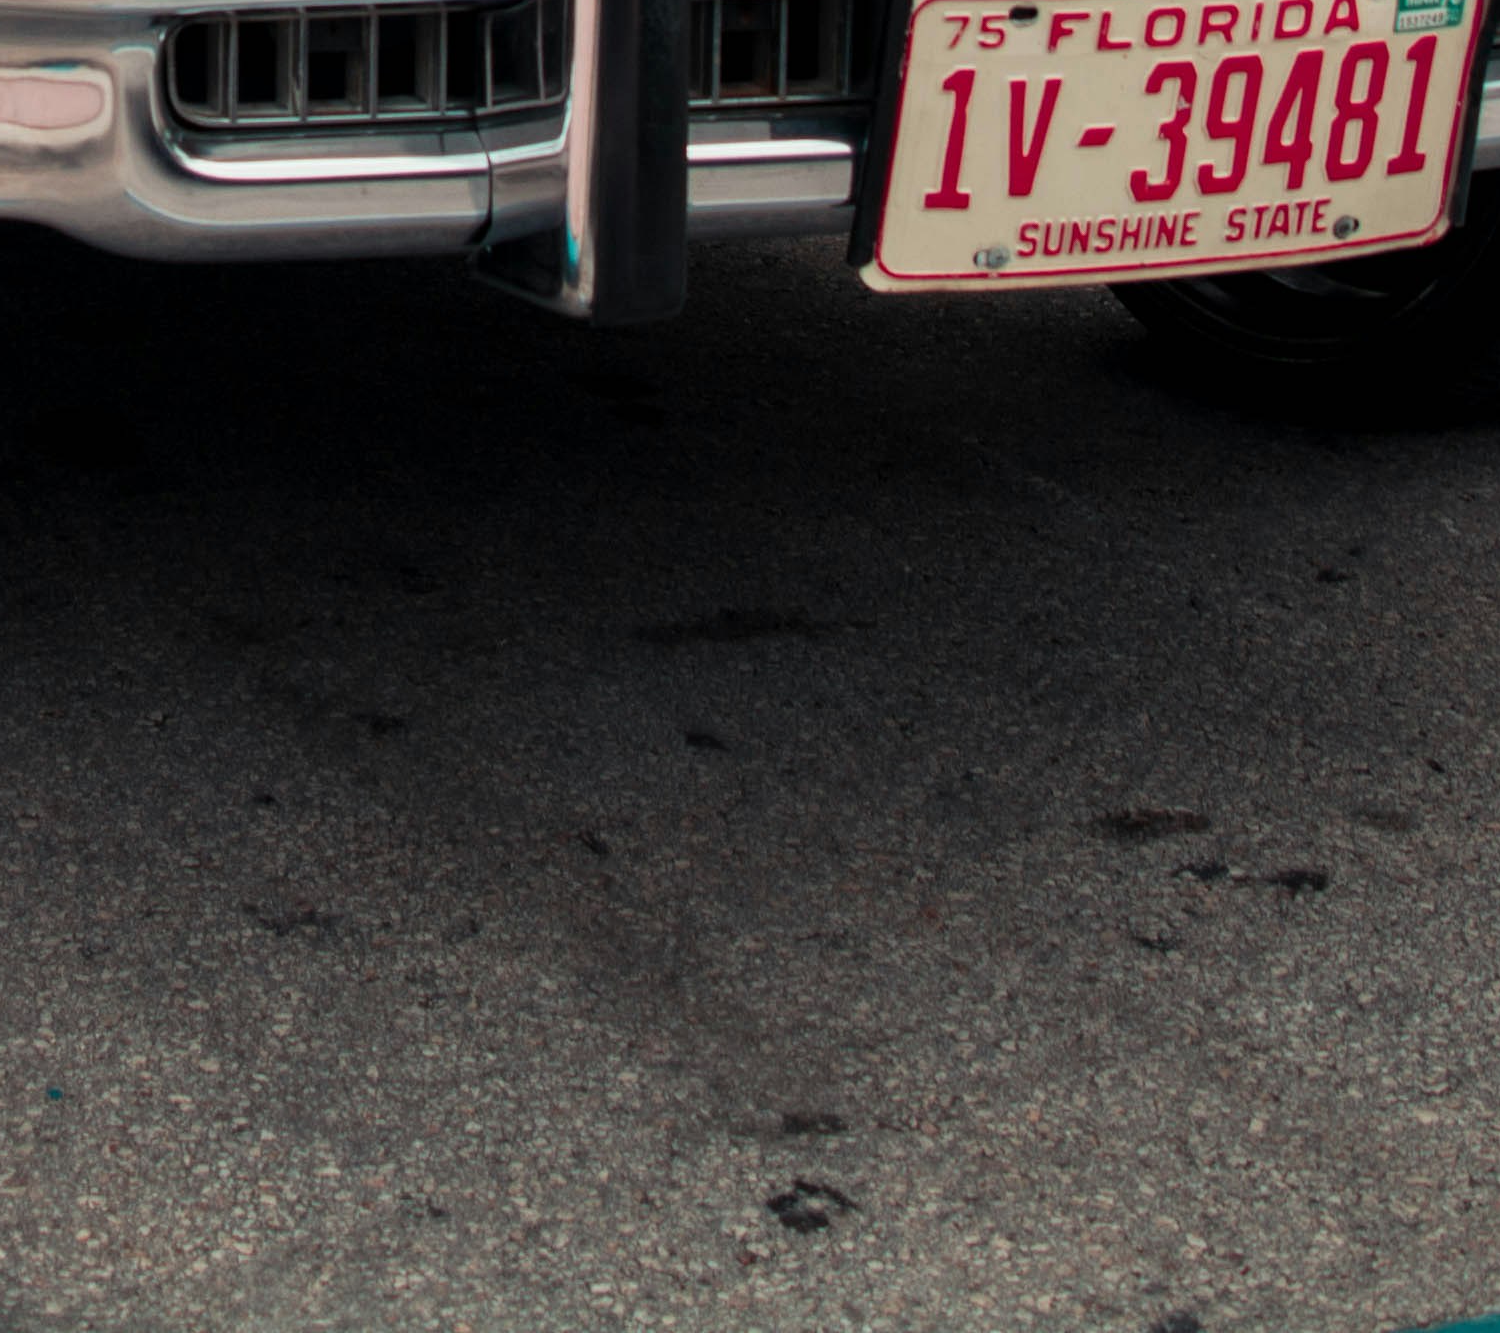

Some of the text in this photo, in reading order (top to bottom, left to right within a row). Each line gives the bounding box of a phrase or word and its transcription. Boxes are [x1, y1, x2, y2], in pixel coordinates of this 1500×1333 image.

[944, 14, 1012, 50] 75
[923, 34, 1439, 211] 1V-39481
[1016, 197, 1333, 258] SUNSHINE STATE
